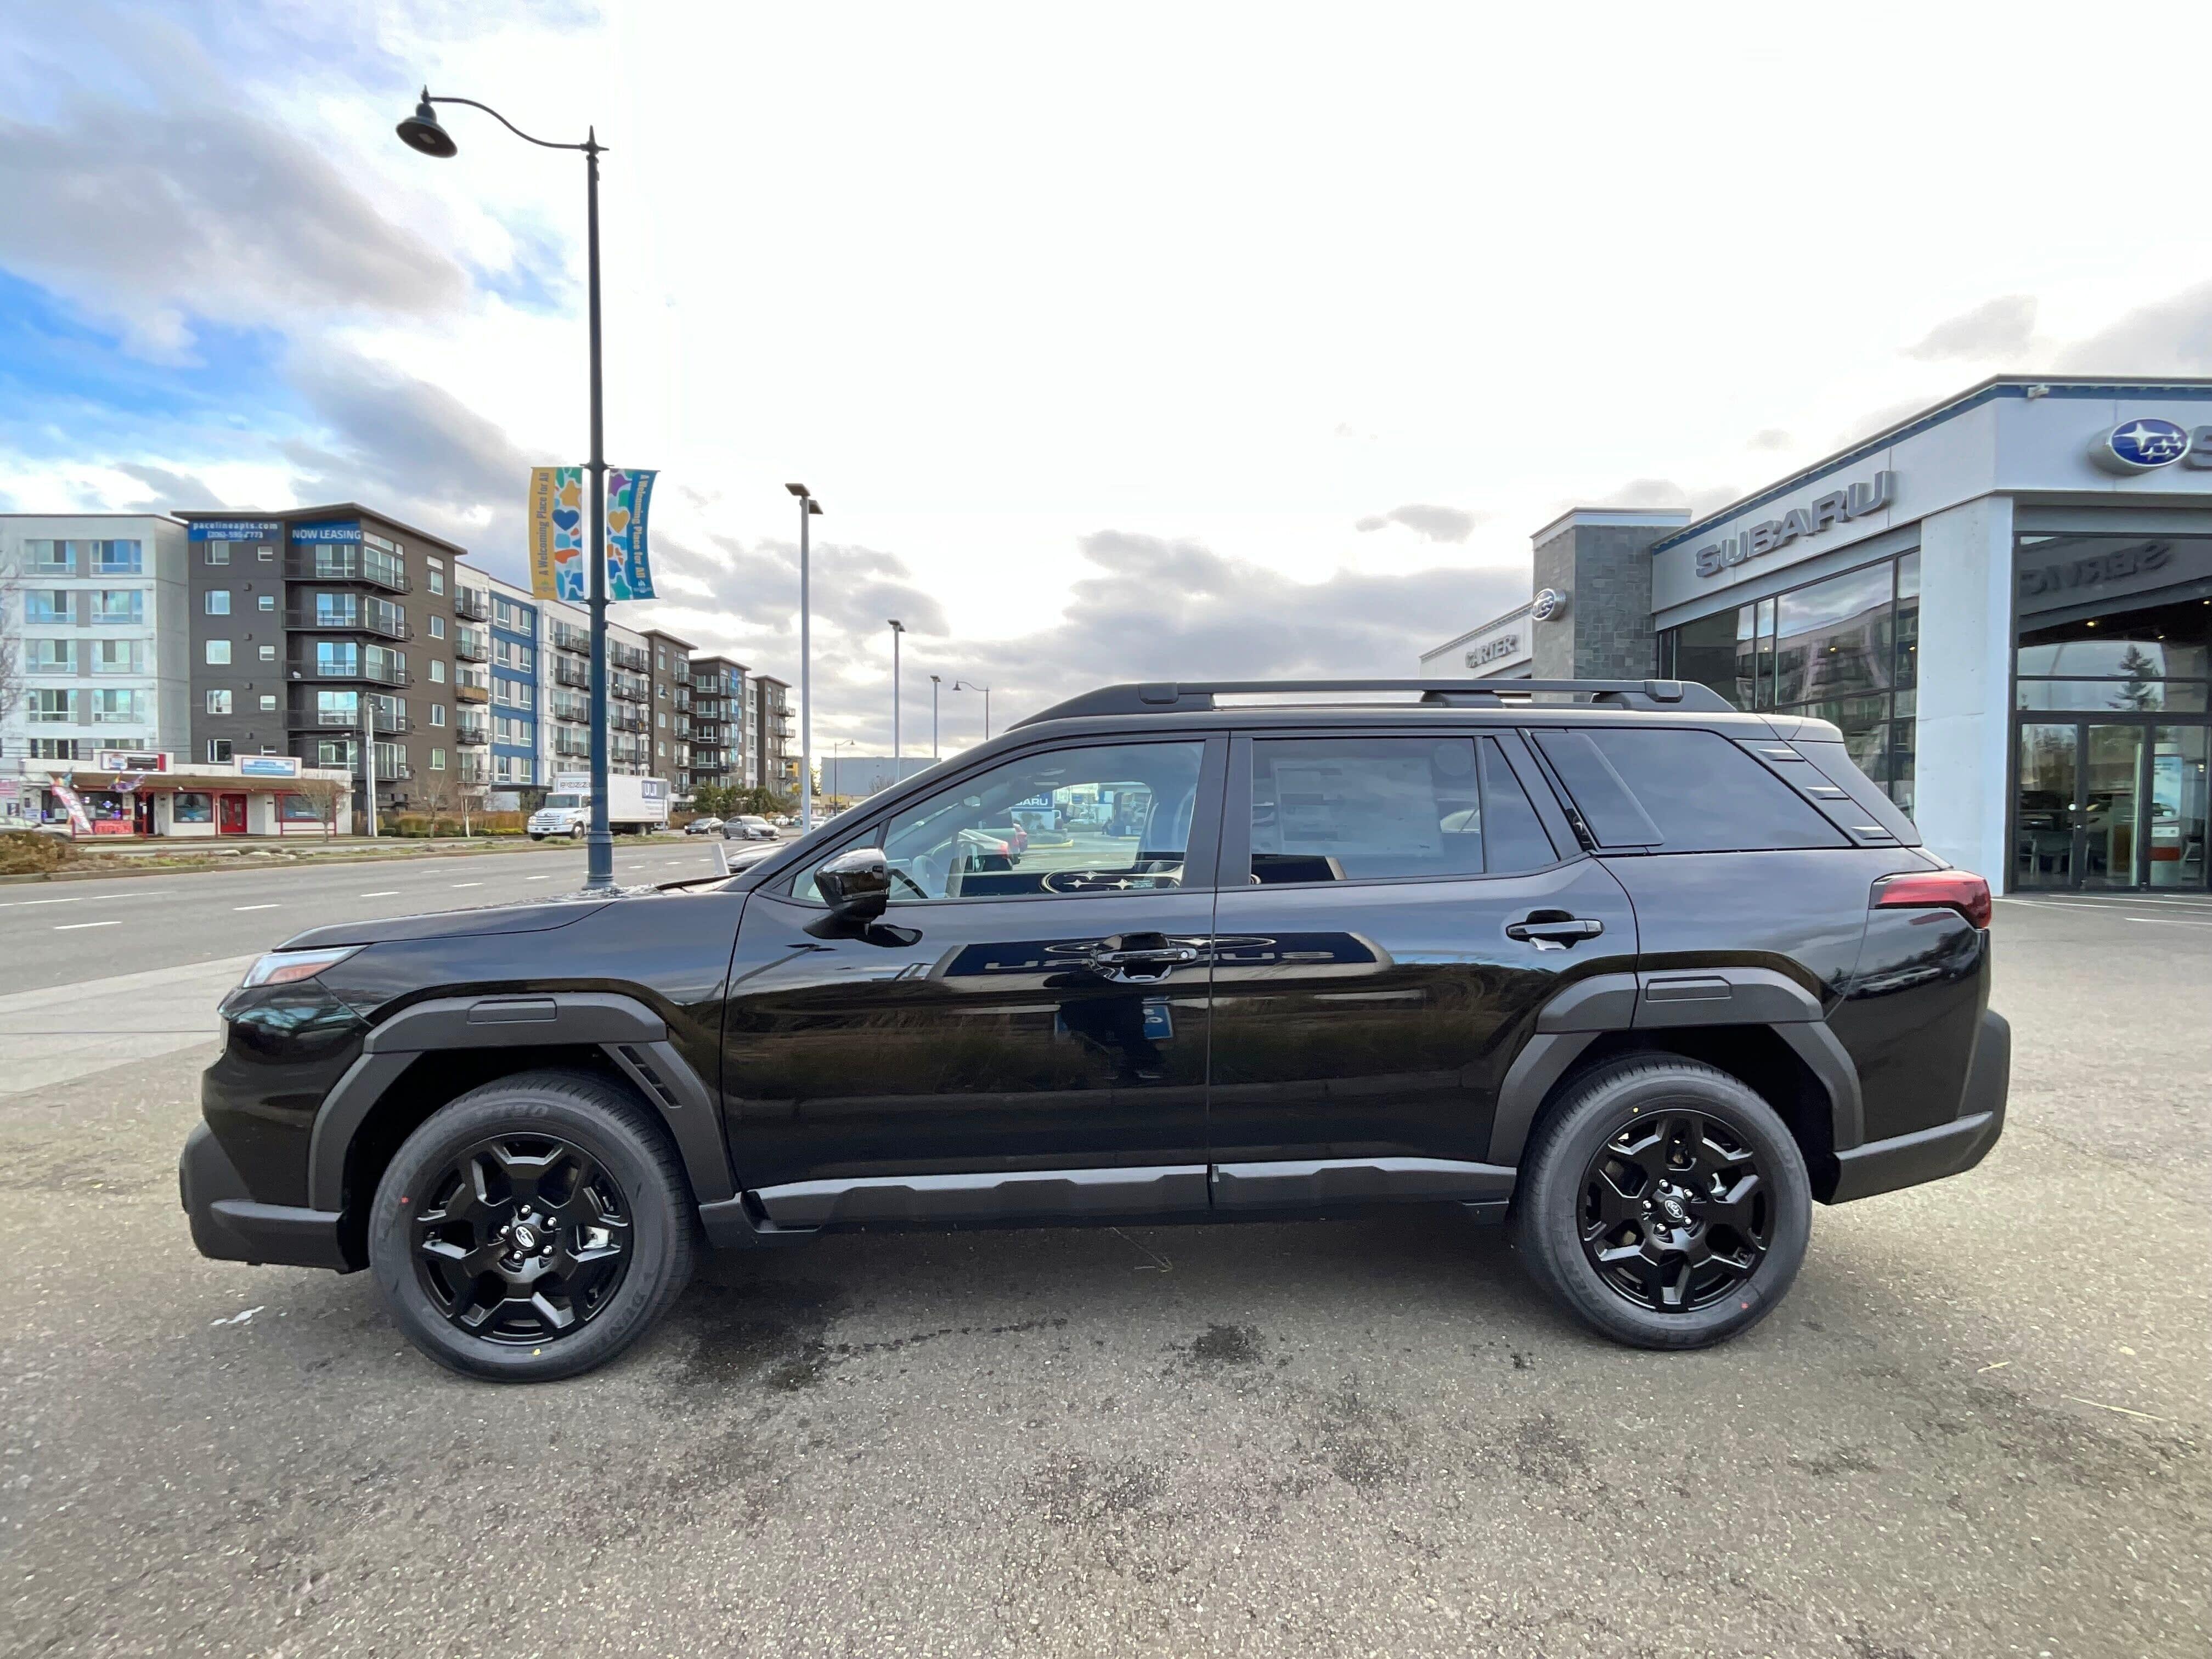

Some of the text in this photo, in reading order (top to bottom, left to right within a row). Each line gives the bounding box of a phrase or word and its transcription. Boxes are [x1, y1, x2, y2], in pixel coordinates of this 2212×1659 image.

[539, 472, 549, 482] All
[538, 483, 548, 495] for
[537, 497, 548, 518] Place
[631, 481, 648, 524] Welcoming
[292, 529, 361, 539] NOW LEASING
[1695, 470, 1894, 578] SUBARU
[537, 521, 549, 566] Welcoming
[633, 526, 642, 549] Place
[634, 552, 643, 564] for
[539, 568, 549, 576] A
[1465, 635, 1519, 668] CARTER
